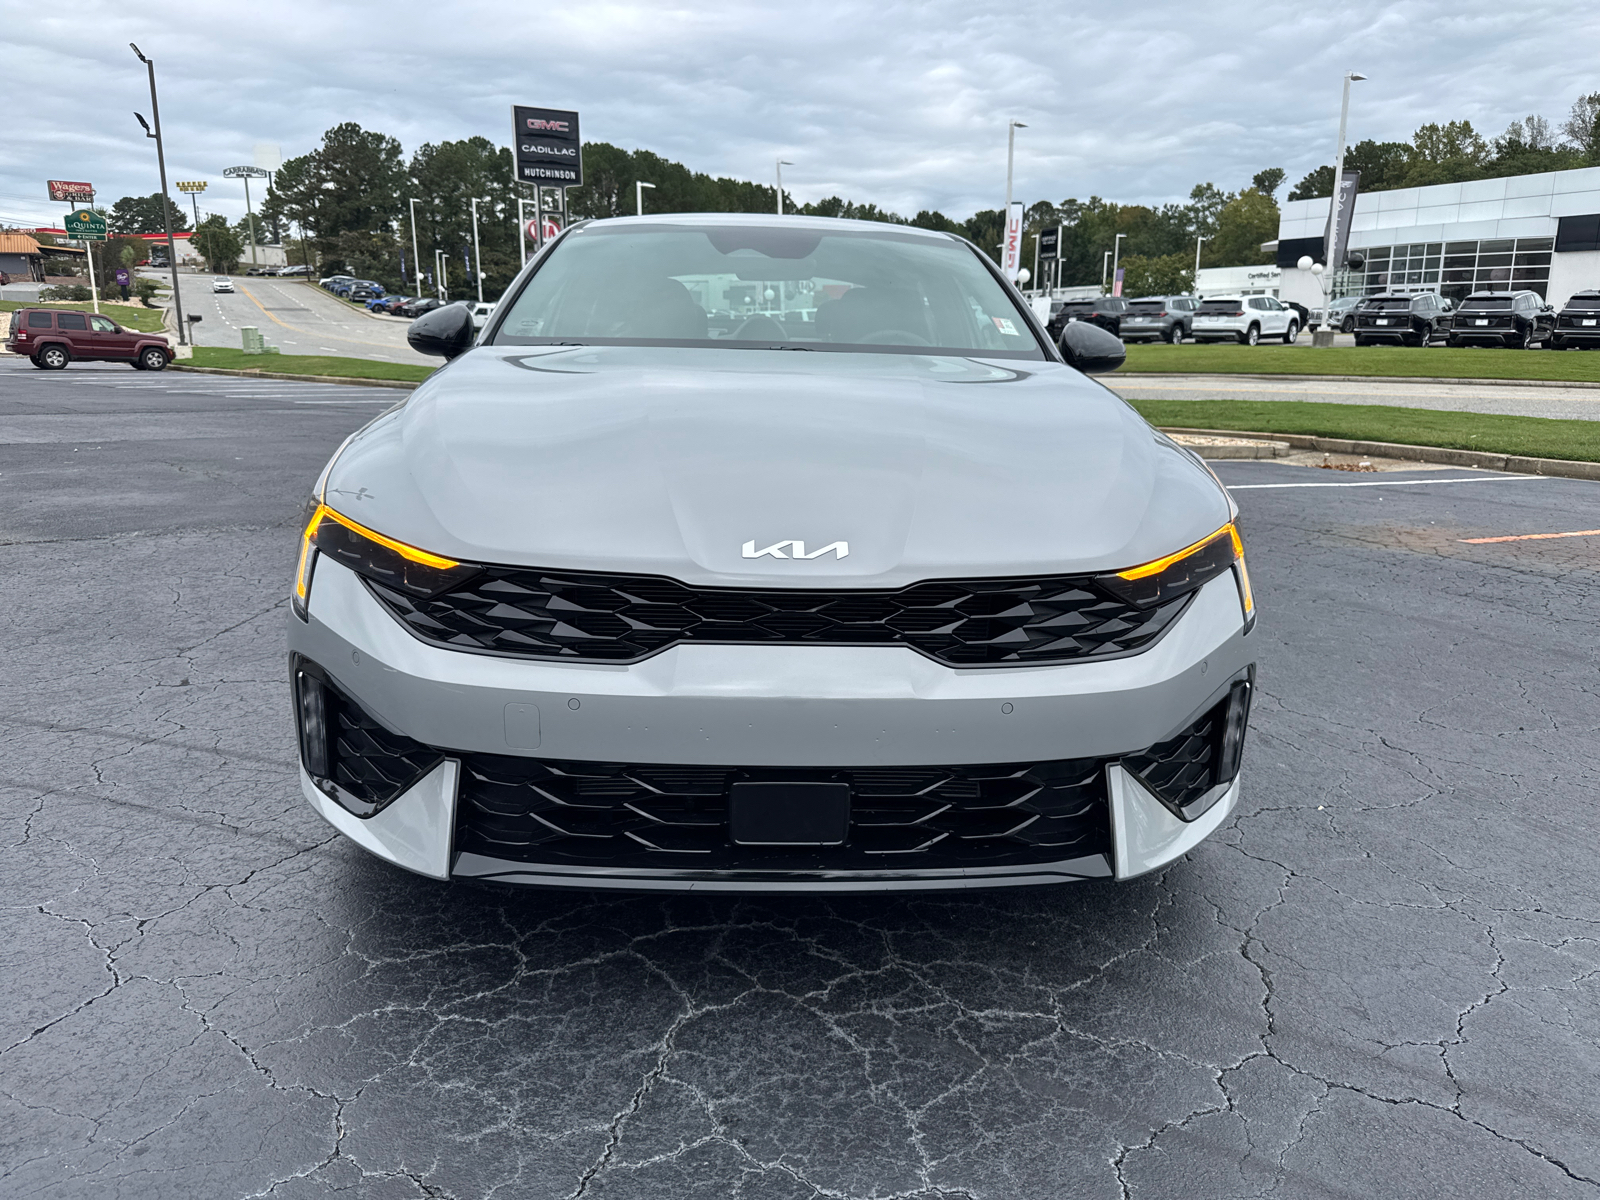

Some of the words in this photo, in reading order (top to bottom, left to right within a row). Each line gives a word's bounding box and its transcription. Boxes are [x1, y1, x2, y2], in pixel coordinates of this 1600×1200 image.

[527, 119, 569, 132] GMC
[521, 144, 576, 156] CADILLAC
[524, 167, 576, 180] HUTCHINSON
[52, 181, 91, 192] Wagers
[73, 221, 105, 229] QUINTA
[742, 539, 849, 560] KIA
